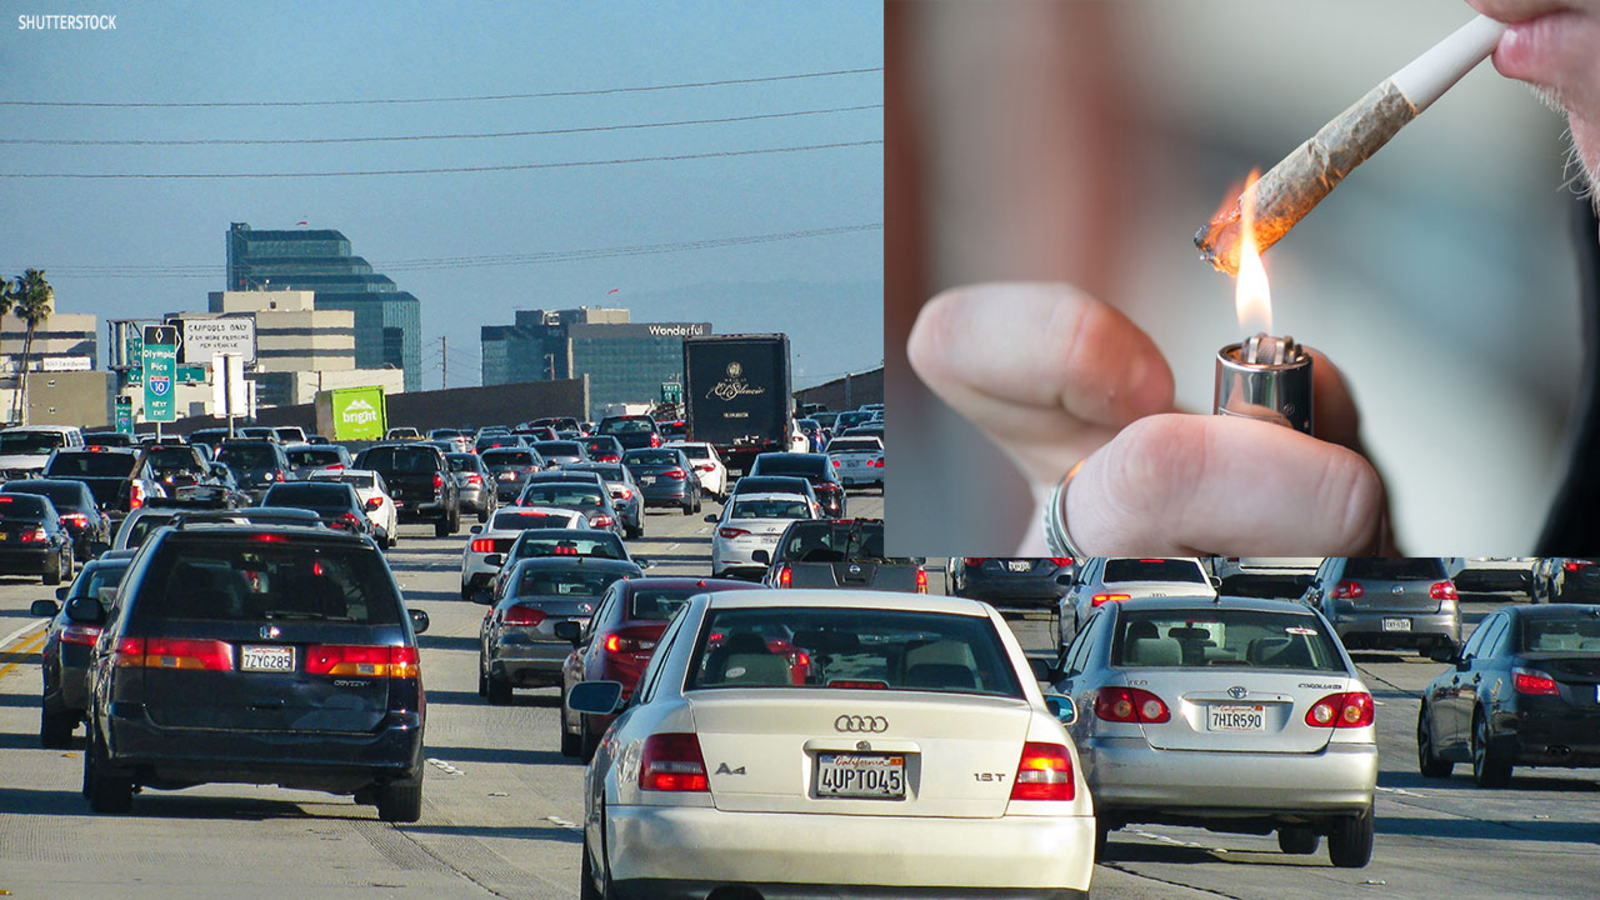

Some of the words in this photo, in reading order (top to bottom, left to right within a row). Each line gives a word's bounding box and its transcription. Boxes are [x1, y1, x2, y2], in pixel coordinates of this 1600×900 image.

[229, 323, 247, 331] ONLY
[649, 324, 704, 336] Wonderful
[144, 349, 175, 359] Olympic
[154, 382, 165, 392] 10
[343, 410, 377, 424] bright
[244, 654, 291, 668] 7ZYG285
[1212, 712, 1261, 728] 7HIR590
[835, 755, 889, 768] California
[714, 762, 746, 775] A4
[822, 768, 900, 791] 4UPT045
